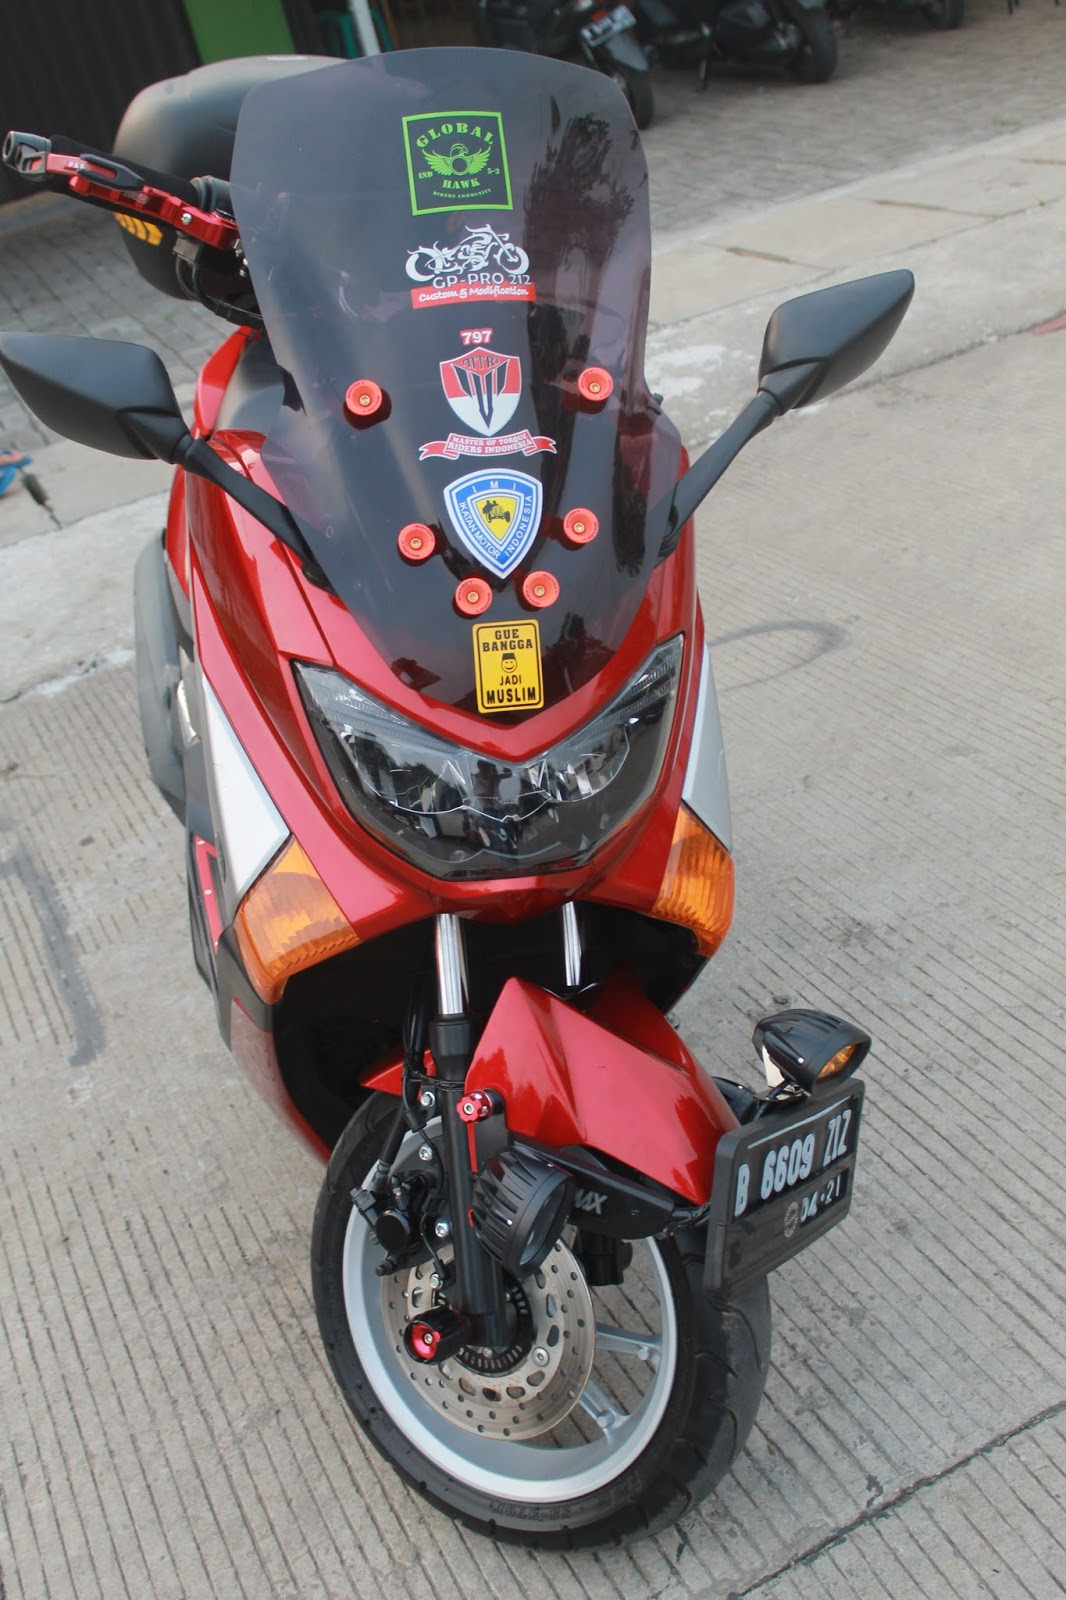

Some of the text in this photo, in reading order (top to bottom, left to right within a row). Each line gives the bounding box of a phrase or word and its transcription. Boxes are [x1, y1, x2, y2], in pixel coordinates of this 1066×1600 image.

[416, 122, 494, 148] GLOBAL
[418, 171, 434, 180] IND
[442, 178, 480, 190] HAWK
[432, 272, 532, 289] GP-PRO 212
[419, 291, 459, 302] Custom
[469, 285, 529, 297] Modification
[461, 330, 492, 345] 797
[448, 439, 533, 454] RIDERS INDONESIA
[452, 436, 484, 446] MASTER
[499, 433, 527, 445] TORQUE
[459, 501, 478, 532] IKATAN
[474, 531, 501, 560] MOTOR
[504, 495, 533, 557] INDONESIA
[495, 629, 520, 640] GUE
[482, 639, 533, 652] BANGGA
[500, 675, 522, 686] JADI
[487, 687, 536, 704] MUSLIM
[735, 1163, 750, 1217] B
[761, 1133, 816, 1200] 6609
